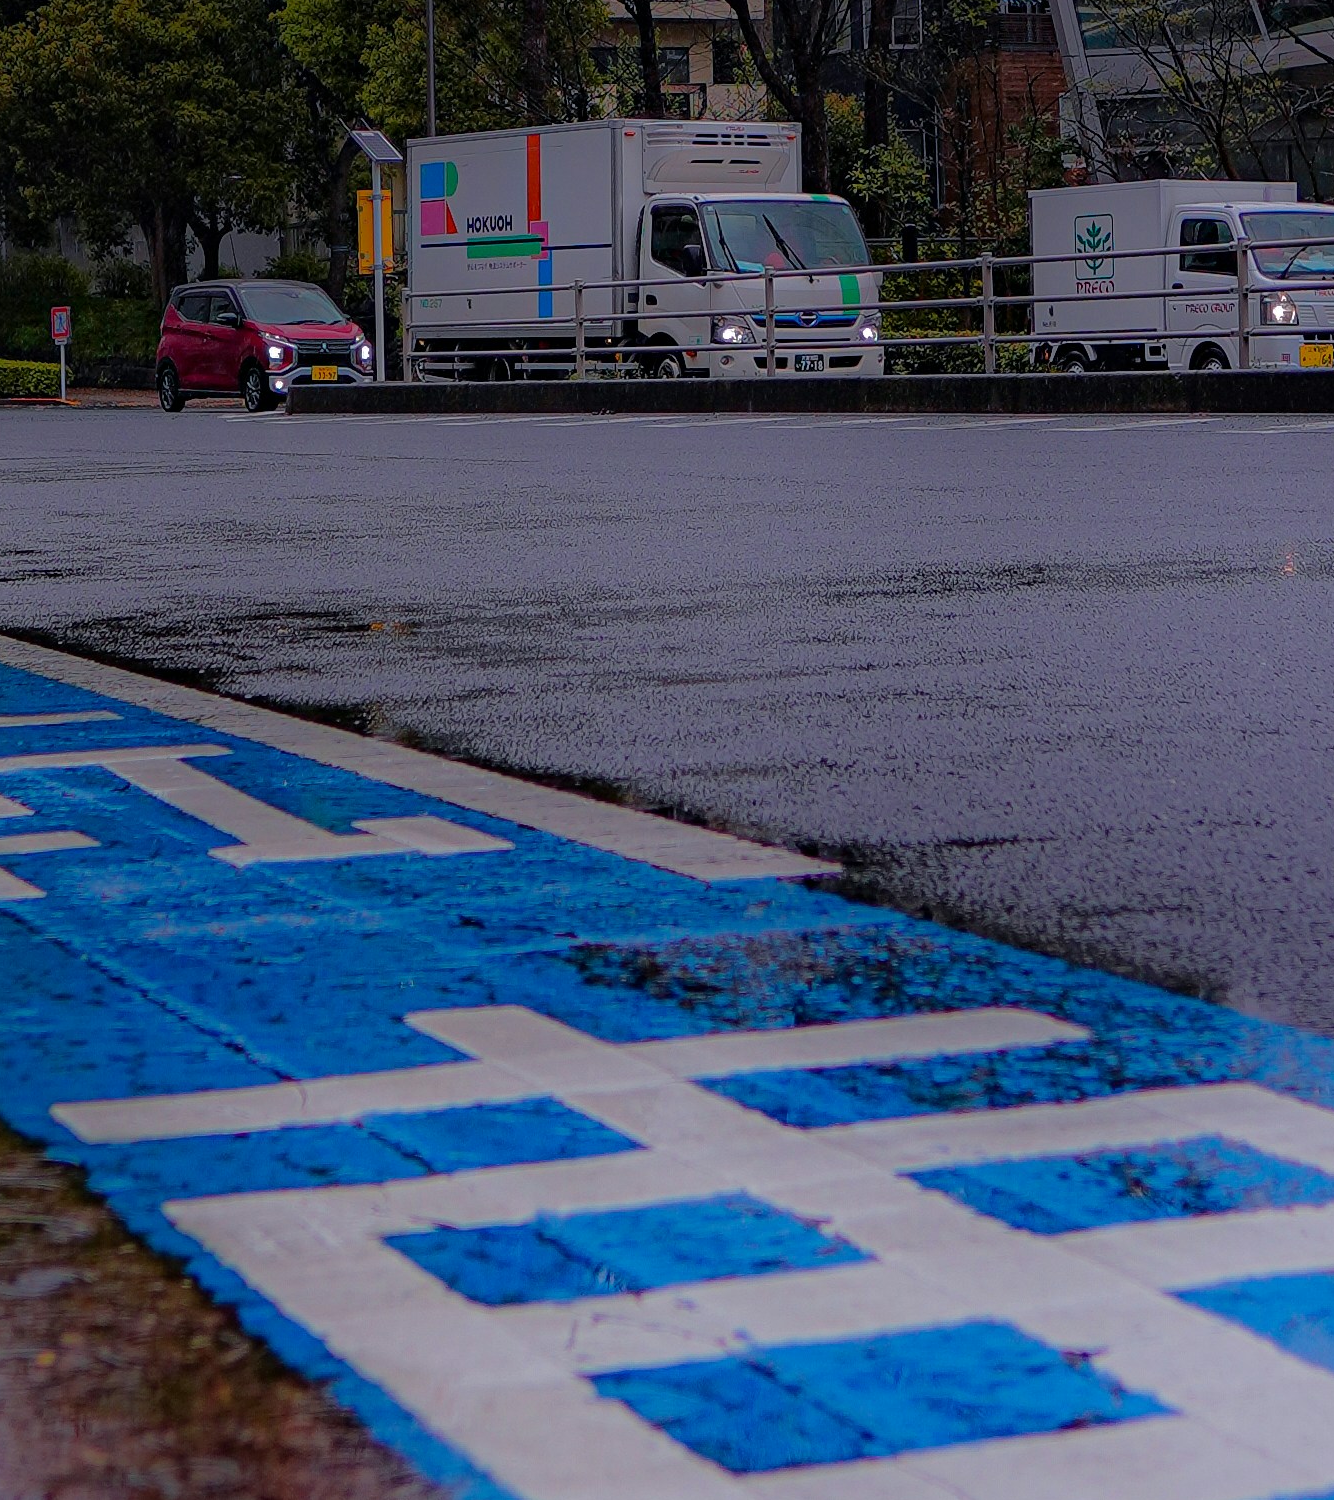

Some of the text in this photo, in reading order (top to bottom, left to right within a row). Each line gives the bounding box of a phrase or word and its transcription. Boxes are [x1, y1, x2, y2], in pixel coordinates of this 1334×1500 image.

[466, 214, 513, 234] HOKUOH
[1075, 280, 1115, 294] PRECO
[1185, 302, 1236, 314] PRECO GROUP
